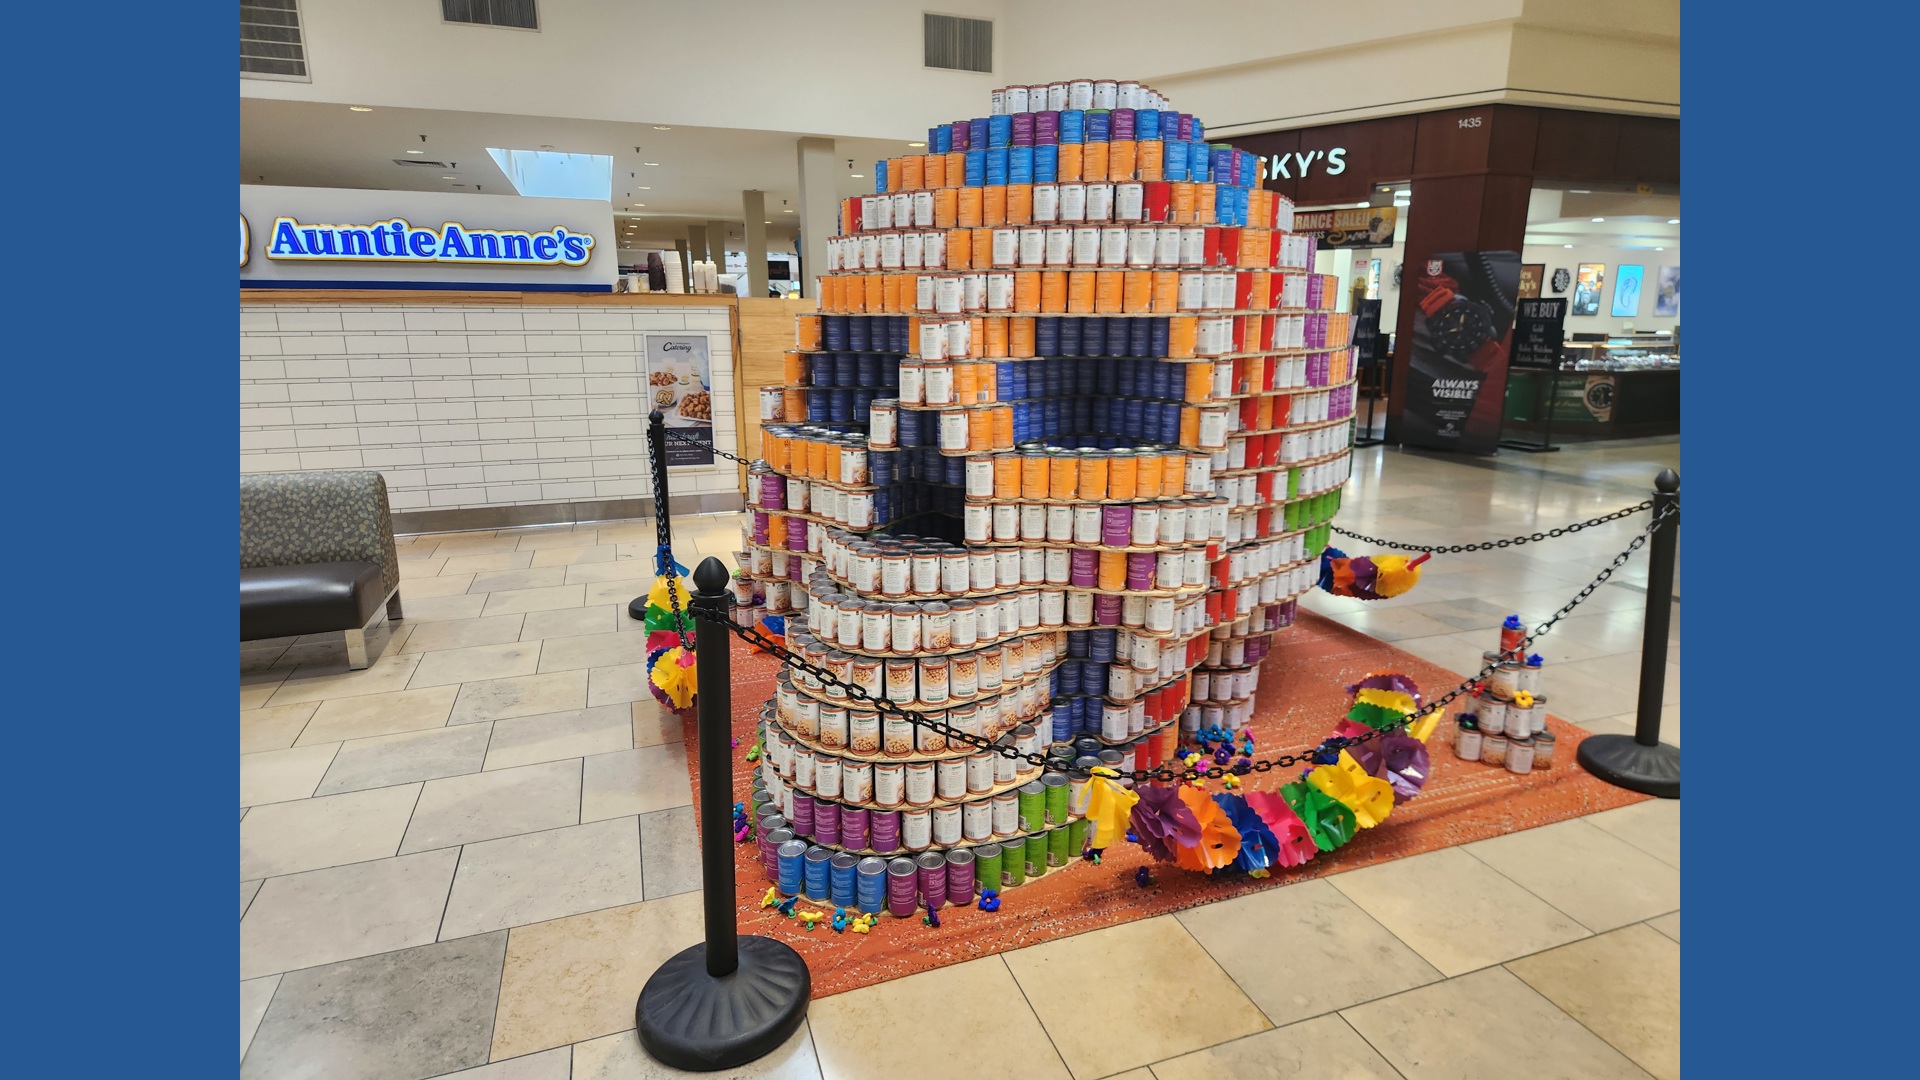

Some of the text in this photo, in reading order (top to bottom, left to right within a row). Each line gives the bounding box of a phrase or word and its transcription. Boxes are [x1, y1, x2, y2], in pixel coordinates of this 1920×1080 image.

[1458, 117, 1482, 129] 1435
[1523, 302, 1560, 318] WE BUY
[662, 341, 692, 353] Catering
[1431, 378, 1479, 390] ALWAYS
[1432, 388, 1474, 400] VISIBLE
